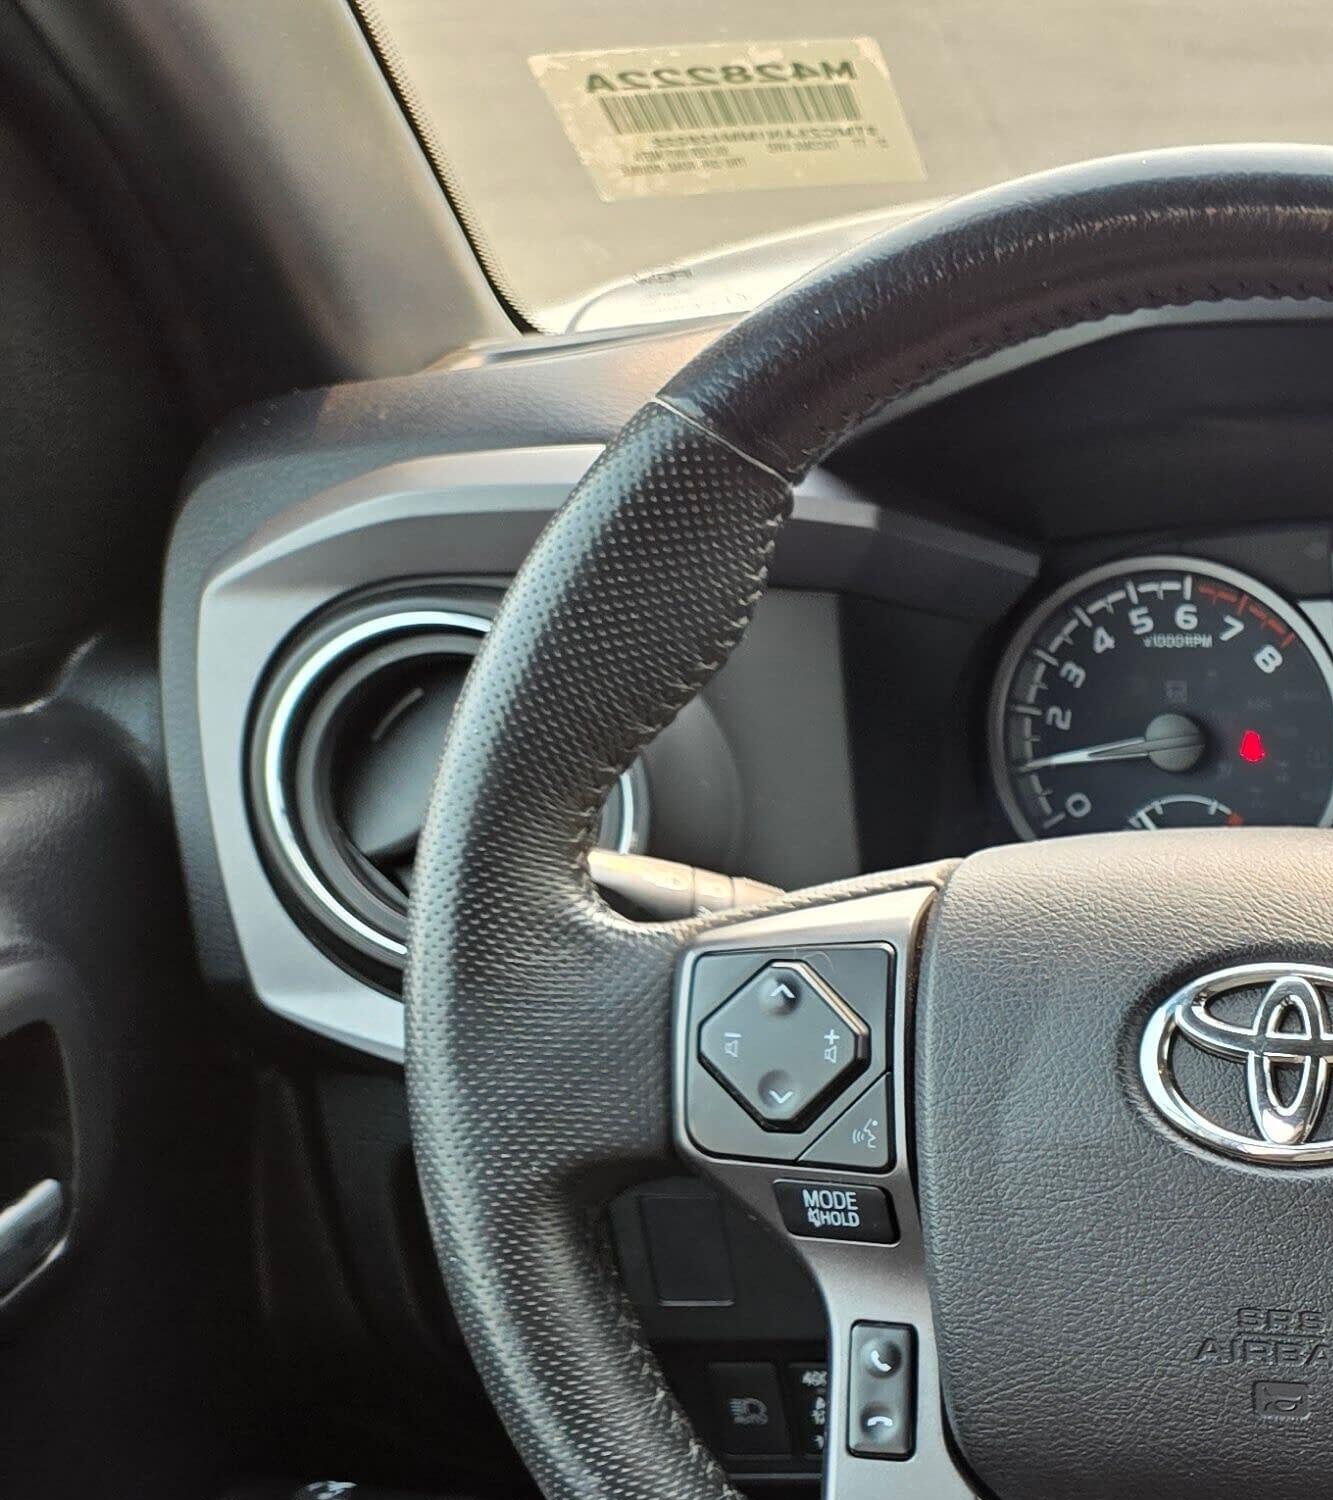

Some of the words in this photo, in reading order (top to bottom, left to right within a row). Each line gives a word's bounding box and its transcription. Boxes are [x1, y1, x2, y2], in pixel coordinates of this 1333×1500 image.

[1128, 607, 1154, 635] 5
[1175, 605, 1198, 629] 6
[1220, 616, 1244, 641] 7
[1093, 627, 1116, 653] 4
[1254, 645, 1283, 673] 8
[1059, 661, 1086, 688] 3
[1046, 707, 1071, 730] 2
[1065, 792, 1091, 817] 0
[803, 1189, 858, 1212] MODE
[819, 1210, 860, 1228] HOLD
